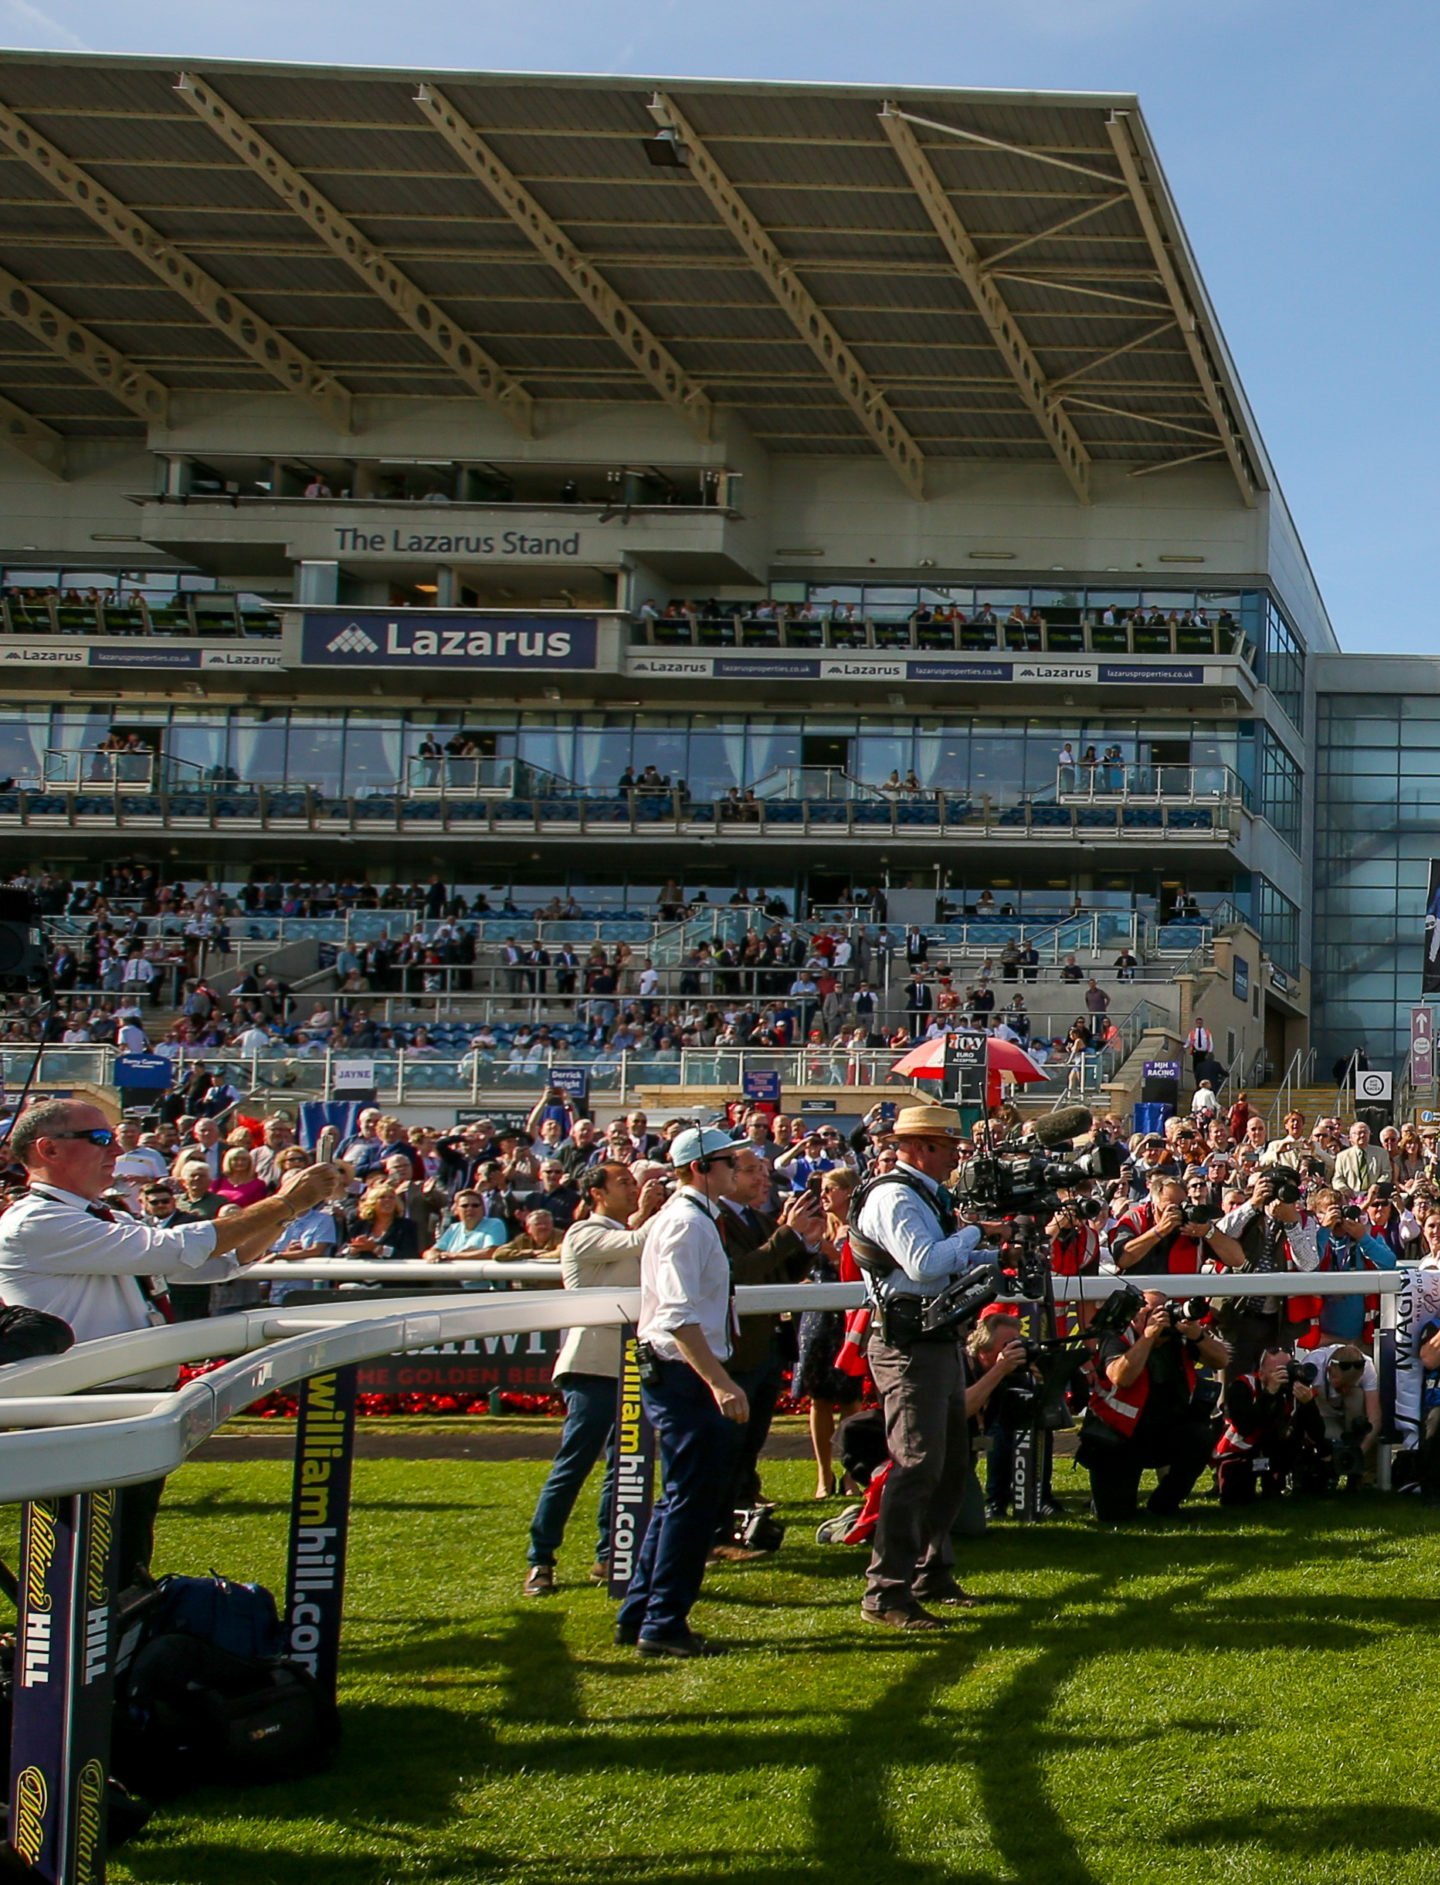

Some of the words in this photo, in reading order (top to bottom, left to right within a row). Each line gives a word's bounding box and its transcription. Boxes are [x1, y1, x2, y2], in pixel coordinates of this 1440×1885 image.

[335, 528, 386, 551] The
[393, 530, 494, 554] Lazarus
[501, 531, 580, 556] Stand
[387, 623, 571, 657] Lazarus
[23, 650, 82, 662] Lazarus
[650, 661, 706, 672] Lazarus
[844, 664, 900, 675] Lazarus
[1036, 667, 1092, 679] Lazarus
[1106, 669, 1194, 680] lazarusproperties.co.uk
[339, 1070, 371, 1079] JAYNE
[1147, 1069, 1175, 1077] RACING
[357, 1368, 390, 1385] HE
[398, 1367, 498, 1385] GOLDEN
[506, 1367, 554, 1384] BEE
[25, 1612, 51, 1688] HILL
[85, 1606, 109, 1686] HILL
[15, 1765, 48, 1866] Willi
